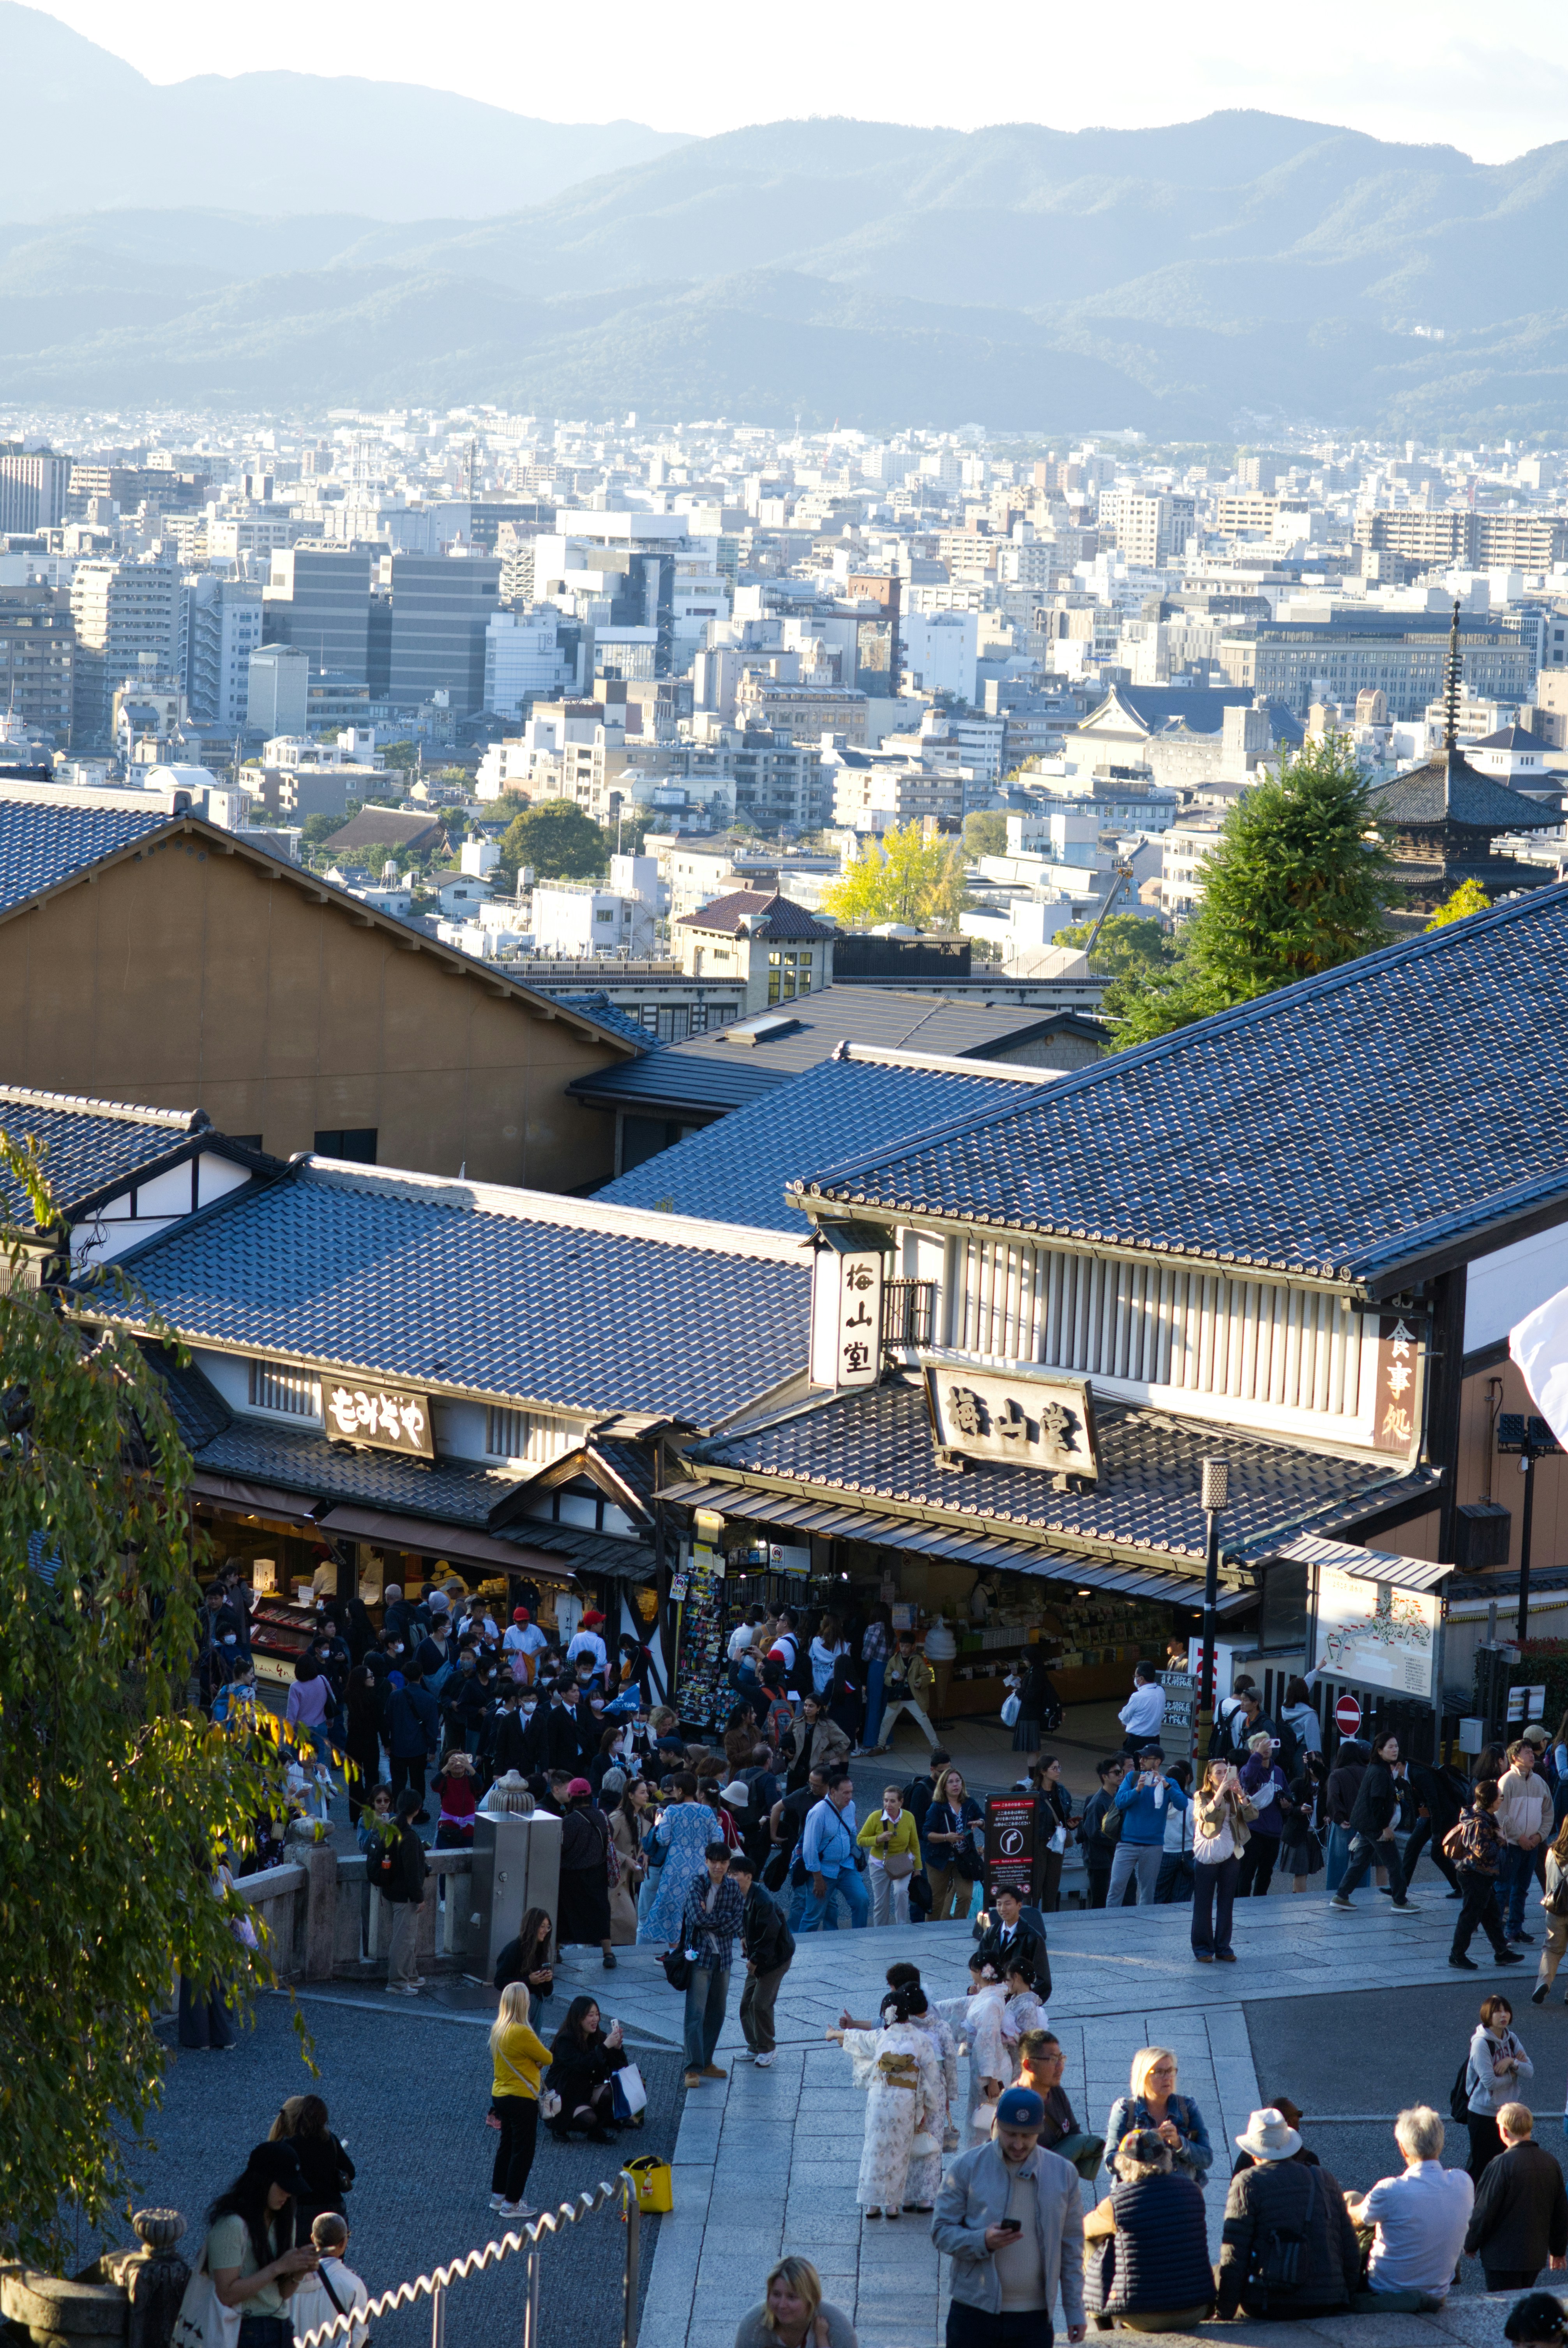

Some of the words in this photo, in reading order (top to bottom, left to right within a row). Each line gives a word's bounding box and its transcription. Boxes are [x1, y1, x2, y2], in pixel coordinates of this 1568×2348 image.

[844, 1263, 874, 1373] 梅山堂
[945, 1386, 1070, 1450] 梅山堂
[1333, 1581, 1347, 1590] ようこそ
[1350, 1584, 1363, 1593] 清水寺
